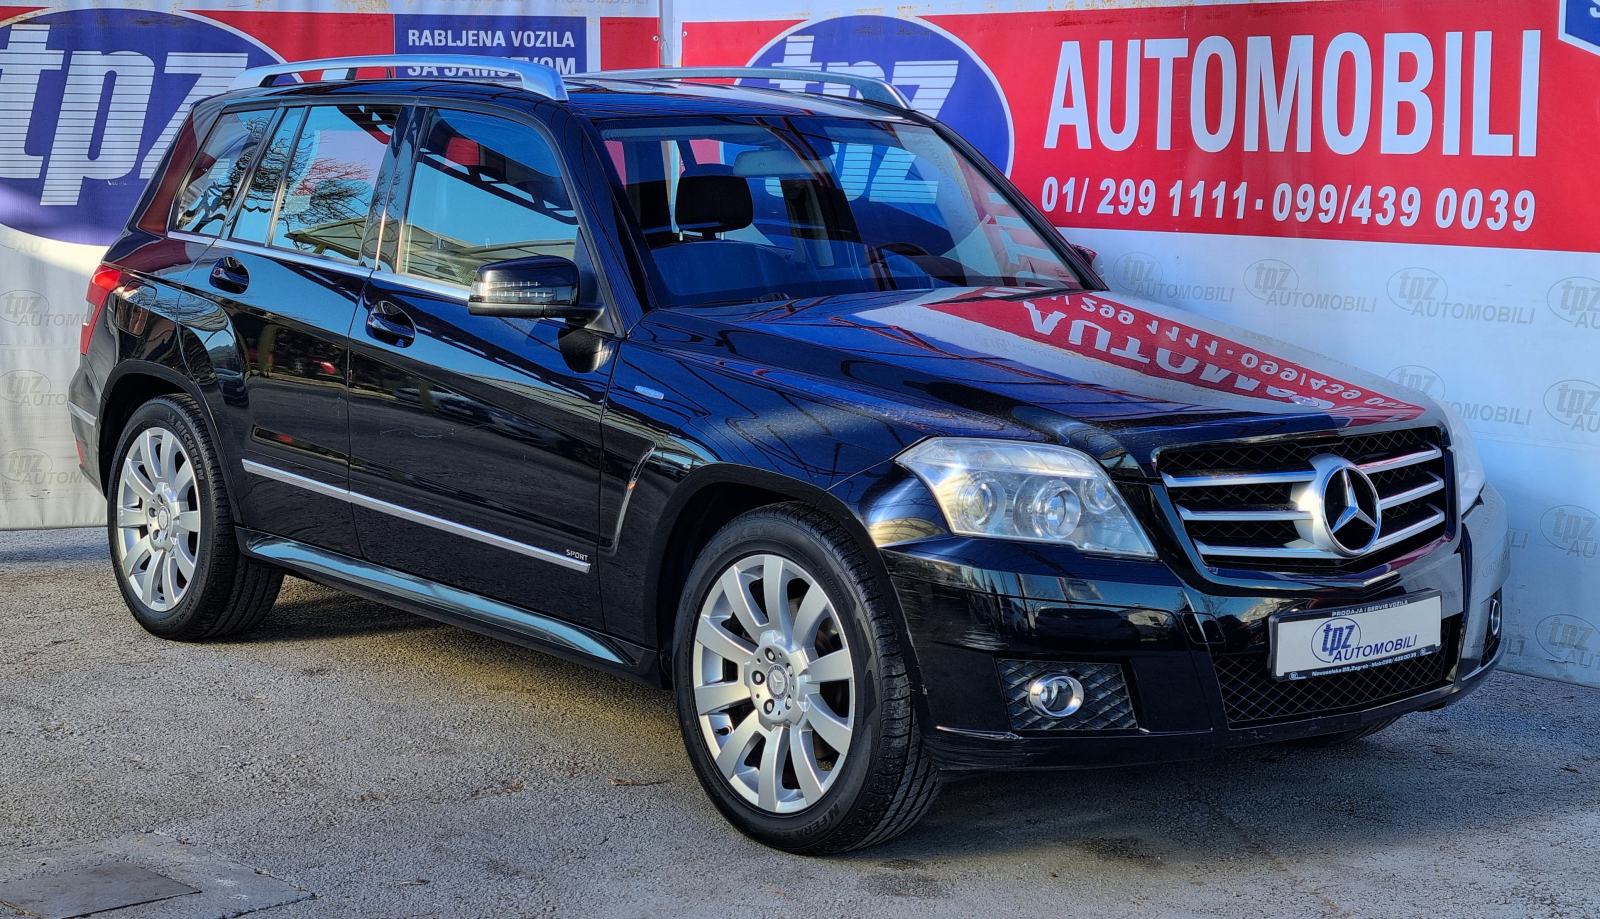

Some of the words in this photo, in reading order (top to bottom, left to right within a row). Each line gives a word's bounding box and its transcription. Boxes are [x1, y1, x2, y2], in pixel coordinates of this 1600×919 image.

[408, 29, 506, 48] RABLJENA
[510, 30, 575, 48] VOZILA
[1043, 30, 1542, 158] AUTOMOBILI
[1041, 176, 1090, 213] 01/
[1096, 177, 1156, 216] 299
[1435, 187, 1536, 232] 0039
[1134, 282, 1235, 303] AUTOMOBILI
[1265, 290, 1377, 313] AUTOMOBILI
[1410, 299, 1536, 325] AUTOMOBILI
[566, 549, 589, 561] SPORT
[1321, 623, 1356, 656] tpz
[1331, 634, 1418, 663] AUTOMOBILI
